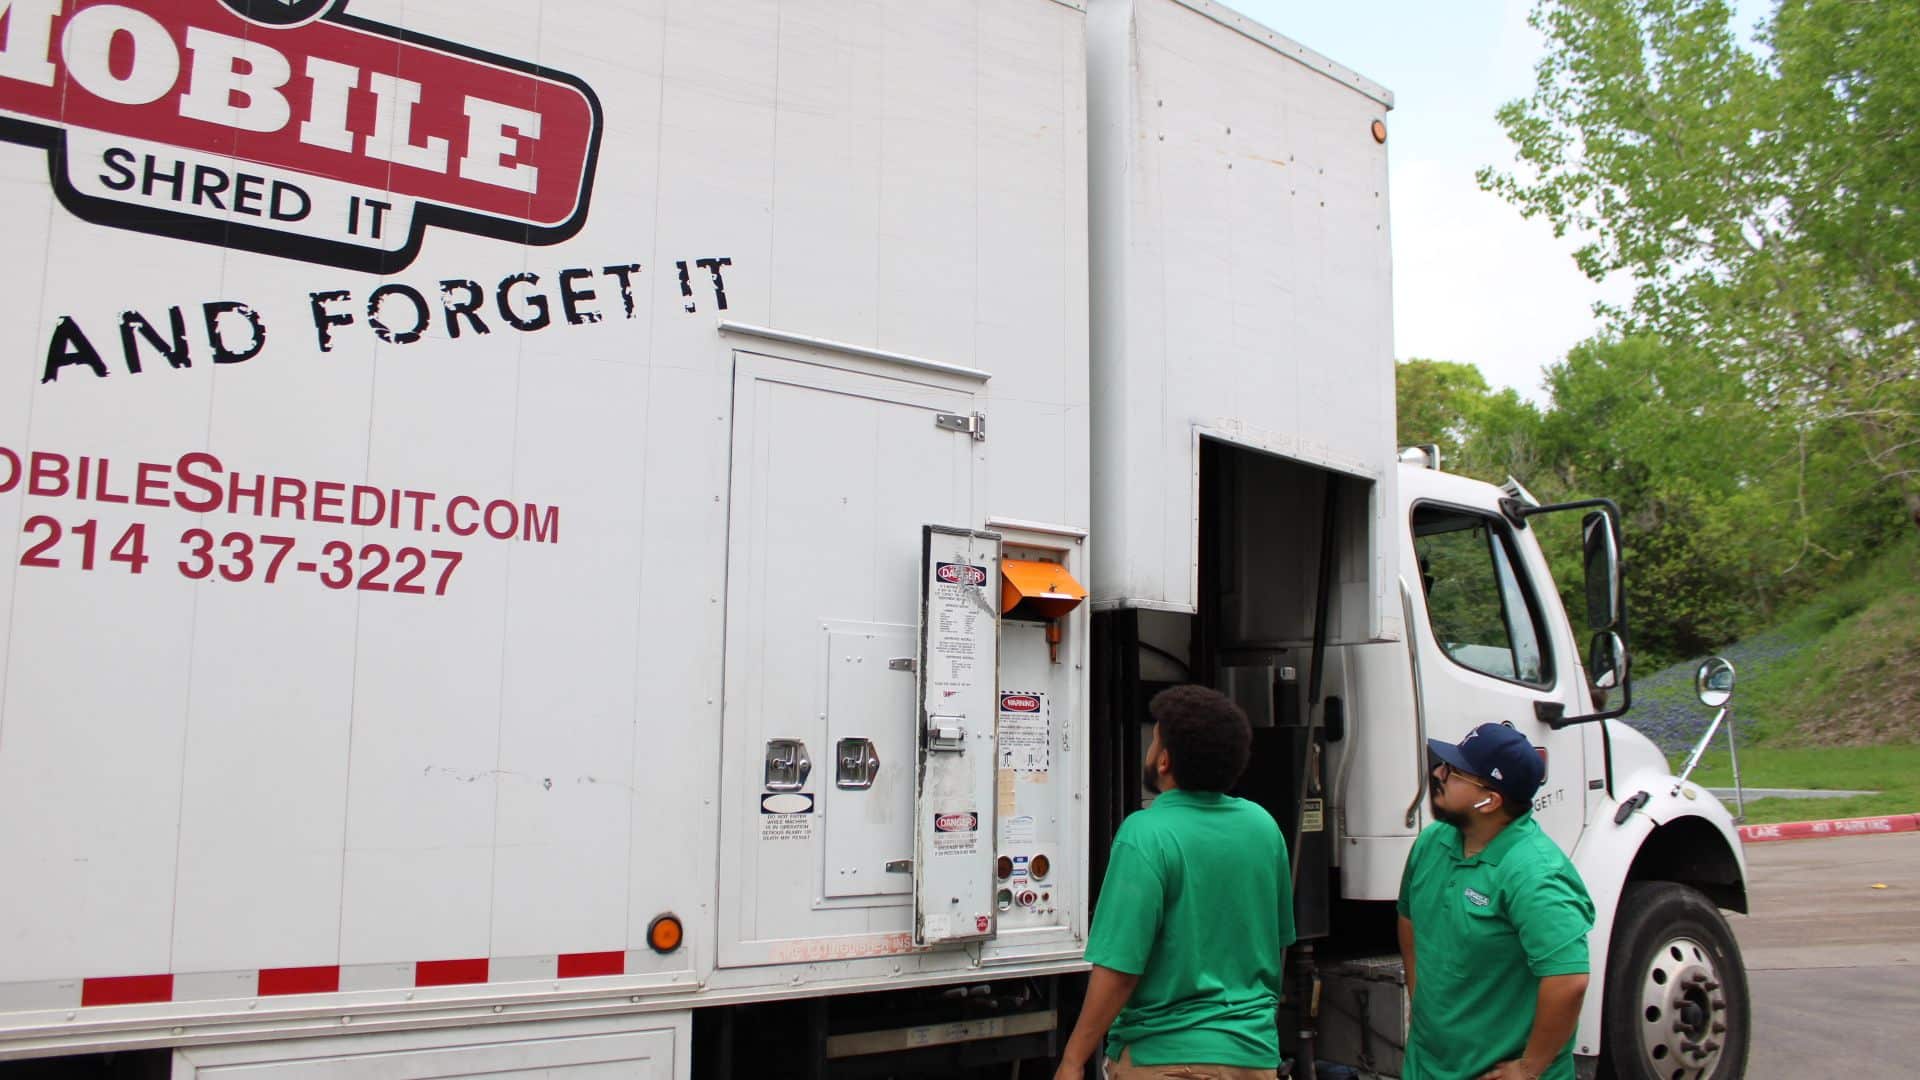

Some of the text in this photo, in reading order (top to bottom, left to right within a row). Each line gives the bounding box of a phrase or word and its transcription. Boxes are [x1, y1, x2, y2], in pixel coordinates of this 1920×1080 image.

[99, 147, 392, 240] SHRED IT
[41, 257, 732, 384] AND FORGET IT
[20, 514, 464, 597] 214 337-3227
